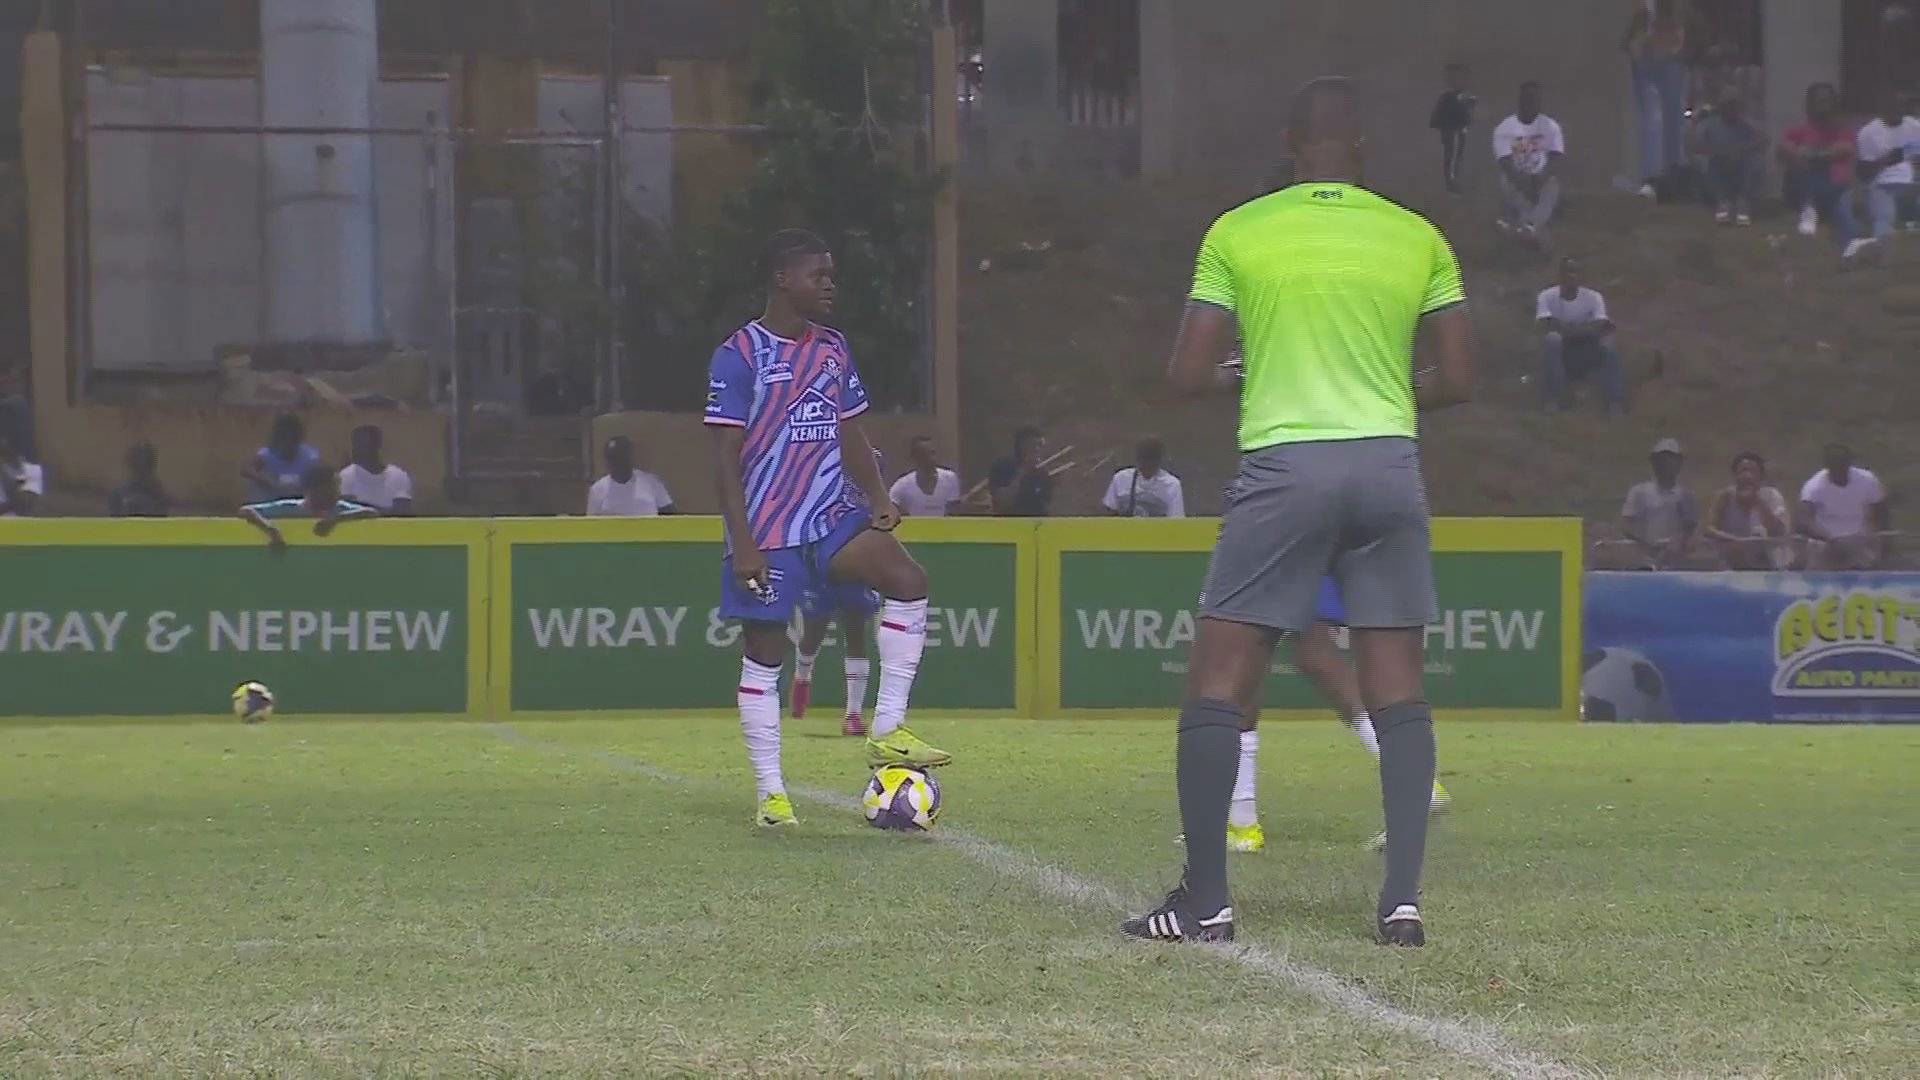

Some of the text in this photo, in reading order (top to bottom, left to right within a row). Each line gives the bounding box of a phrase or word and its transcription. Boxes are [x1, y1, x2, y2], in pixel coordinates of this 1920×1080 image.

[791, 425, 838, 442] KEMTEK
[0, 610, 450, 654] RAY & NEPHEW
[528, 606, 687, 649] WRAY
[1077, 608, 1196, 650] WRA
[1796, 670, 1855, 687] AUTO
